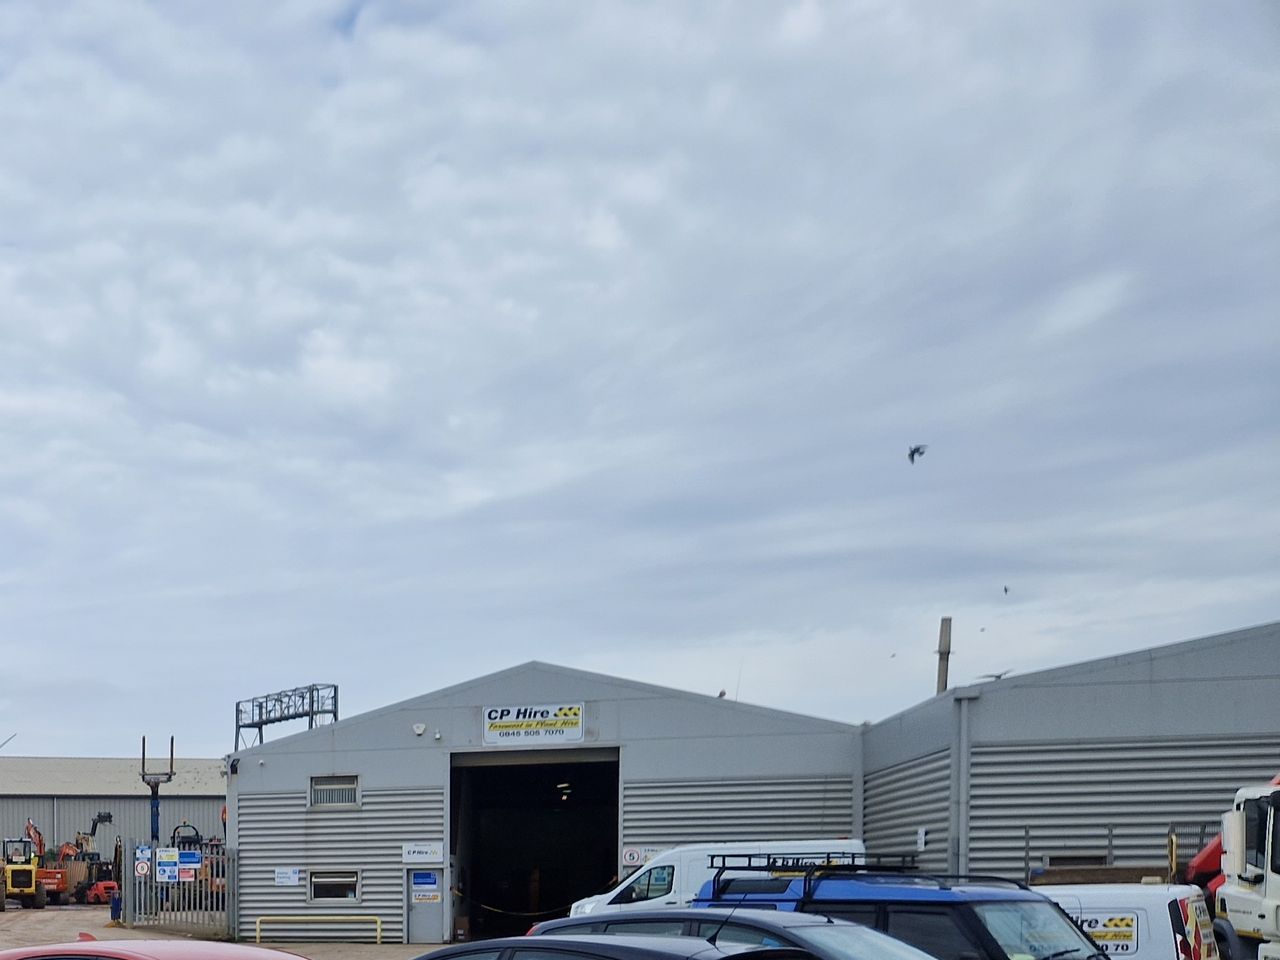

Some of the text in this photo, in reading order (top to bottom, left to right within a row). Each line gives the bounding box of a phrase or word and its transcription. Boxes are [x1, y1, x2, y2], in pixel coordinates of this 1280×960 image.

[487, 707, 550, 721] CP Hire
[535, 720, 558, 729] Plant
[560, 719, 579, 728] Hire
[544, 728, 565, 736] 7070
[629, 852, 635, 861] 5
[1113, 943, 1129, 952] 70
